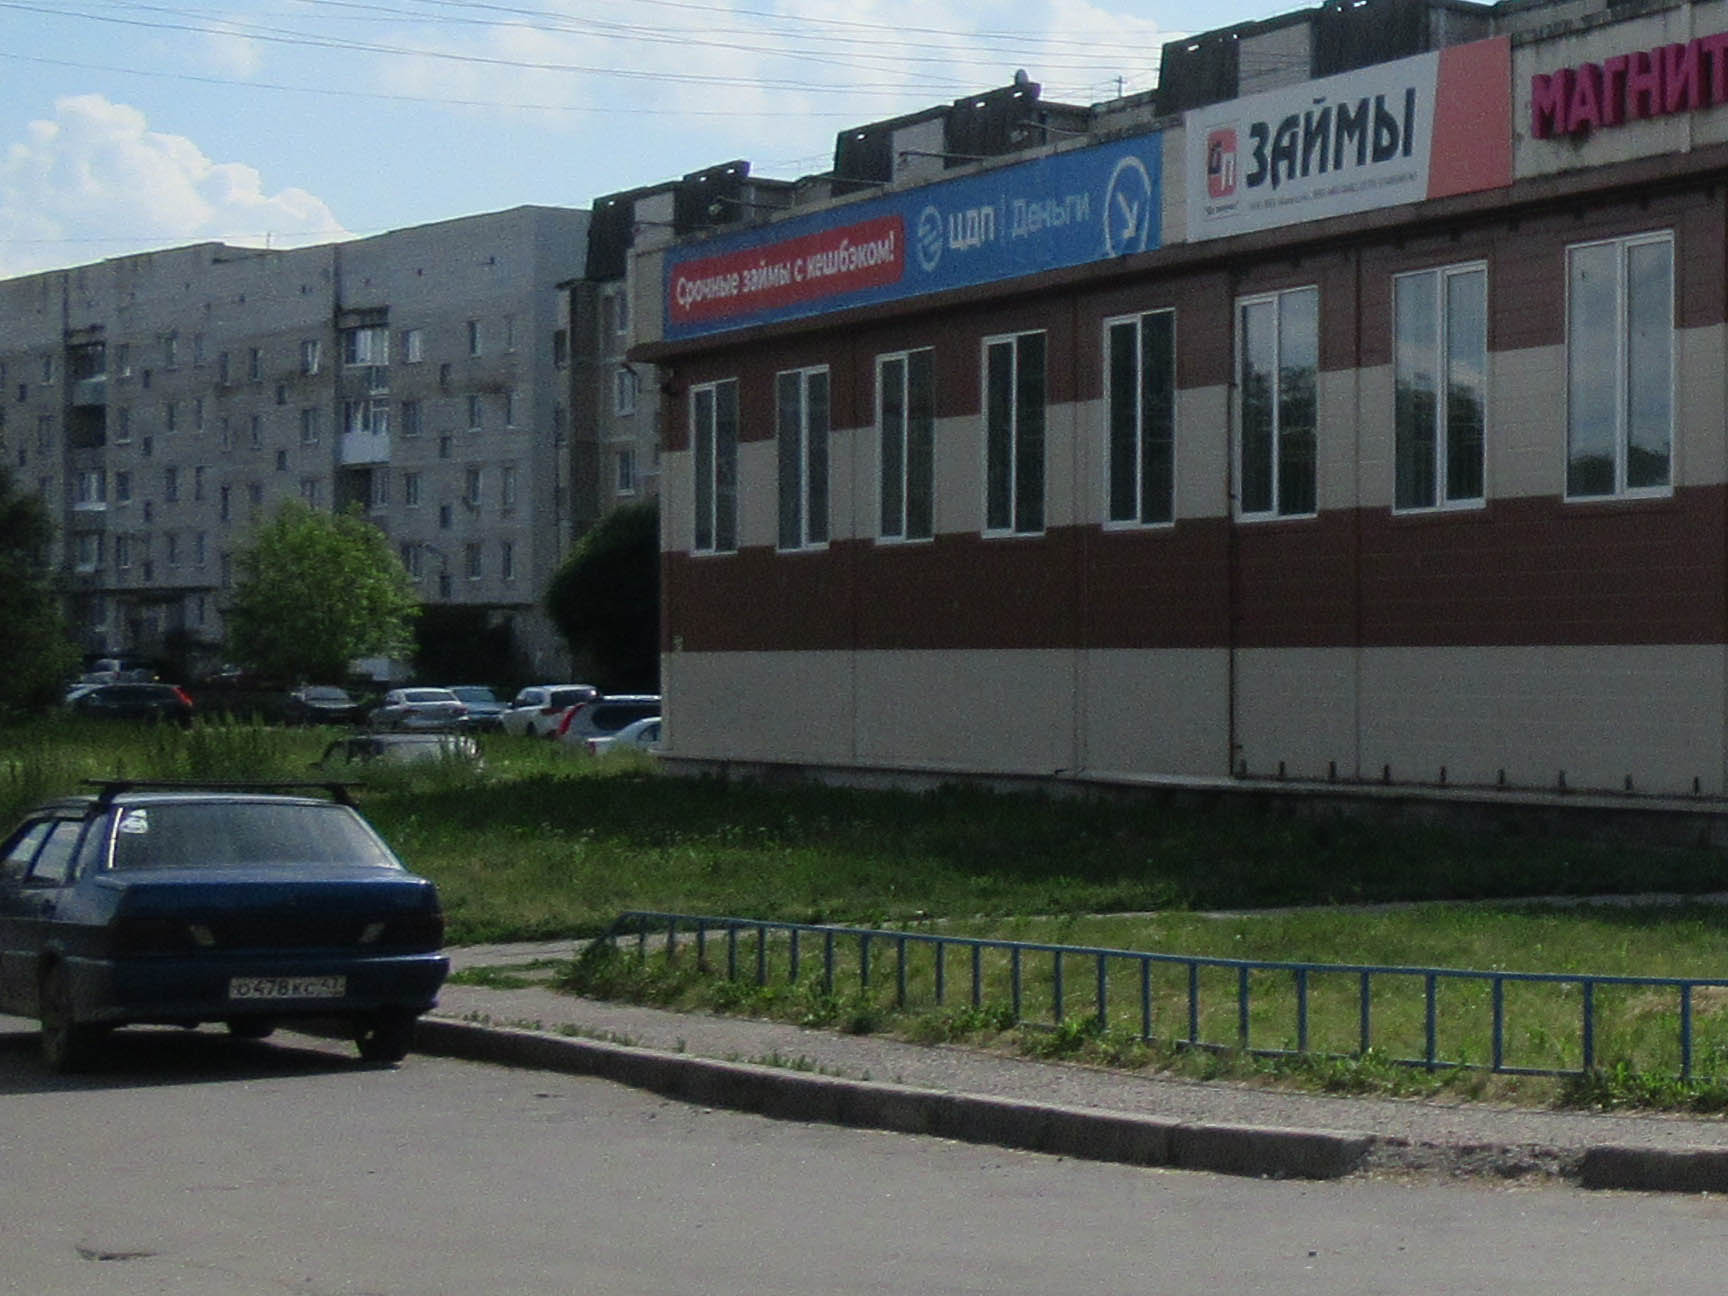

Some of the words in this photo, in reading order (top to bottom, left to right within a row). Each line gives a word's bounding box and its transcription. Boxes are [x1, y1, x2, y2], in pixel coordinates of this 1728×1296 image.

[1246, 87, 1416, 191] ЗАЙМЫ
[949, 206, 995, 251] ЦДП
[1012, 193, 1090, 239] Деньги
[676, 271, 740, 312] Срочные
[743, 259, 791, 293] займы
[807, 230, 895, 281] кешбэком!
